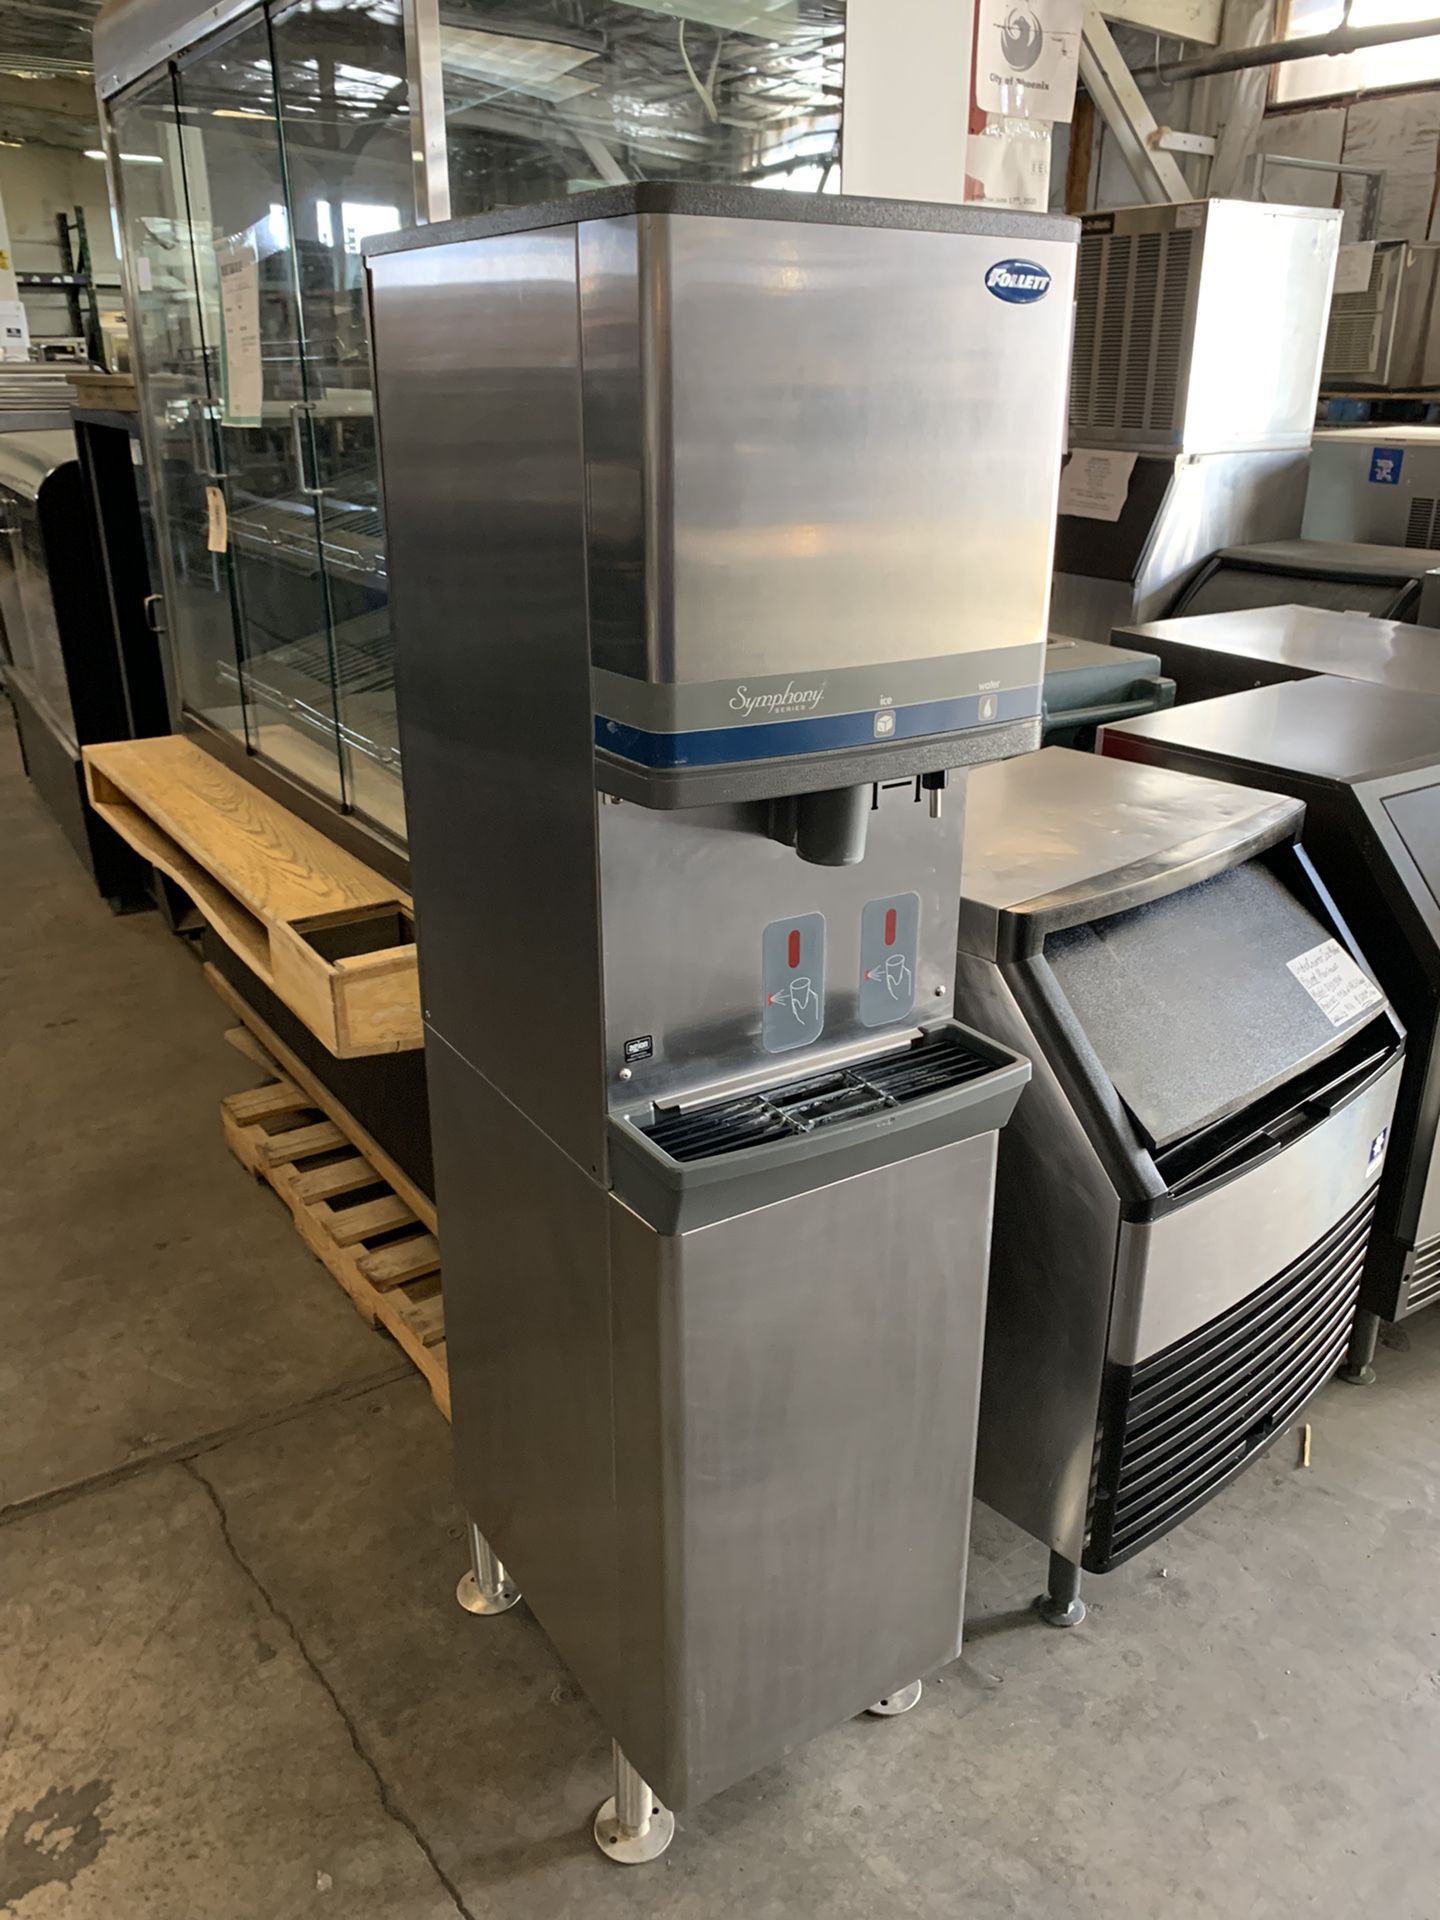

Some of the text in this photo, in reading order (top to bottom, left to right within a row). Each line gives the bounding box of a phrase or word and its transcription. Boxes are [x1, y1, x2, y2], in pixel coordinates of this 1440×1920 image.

[989, 73, 1002, 86] City
[1004, 77, 1013, 85] of
[987, 268, 1050, 291] FOLLETT
[978, 680, 1001, 691] water
[729, 680, 825, 718] Symphony
[879, 695, 893, 706] ice
[774, 704, 806, 714] SERIES
